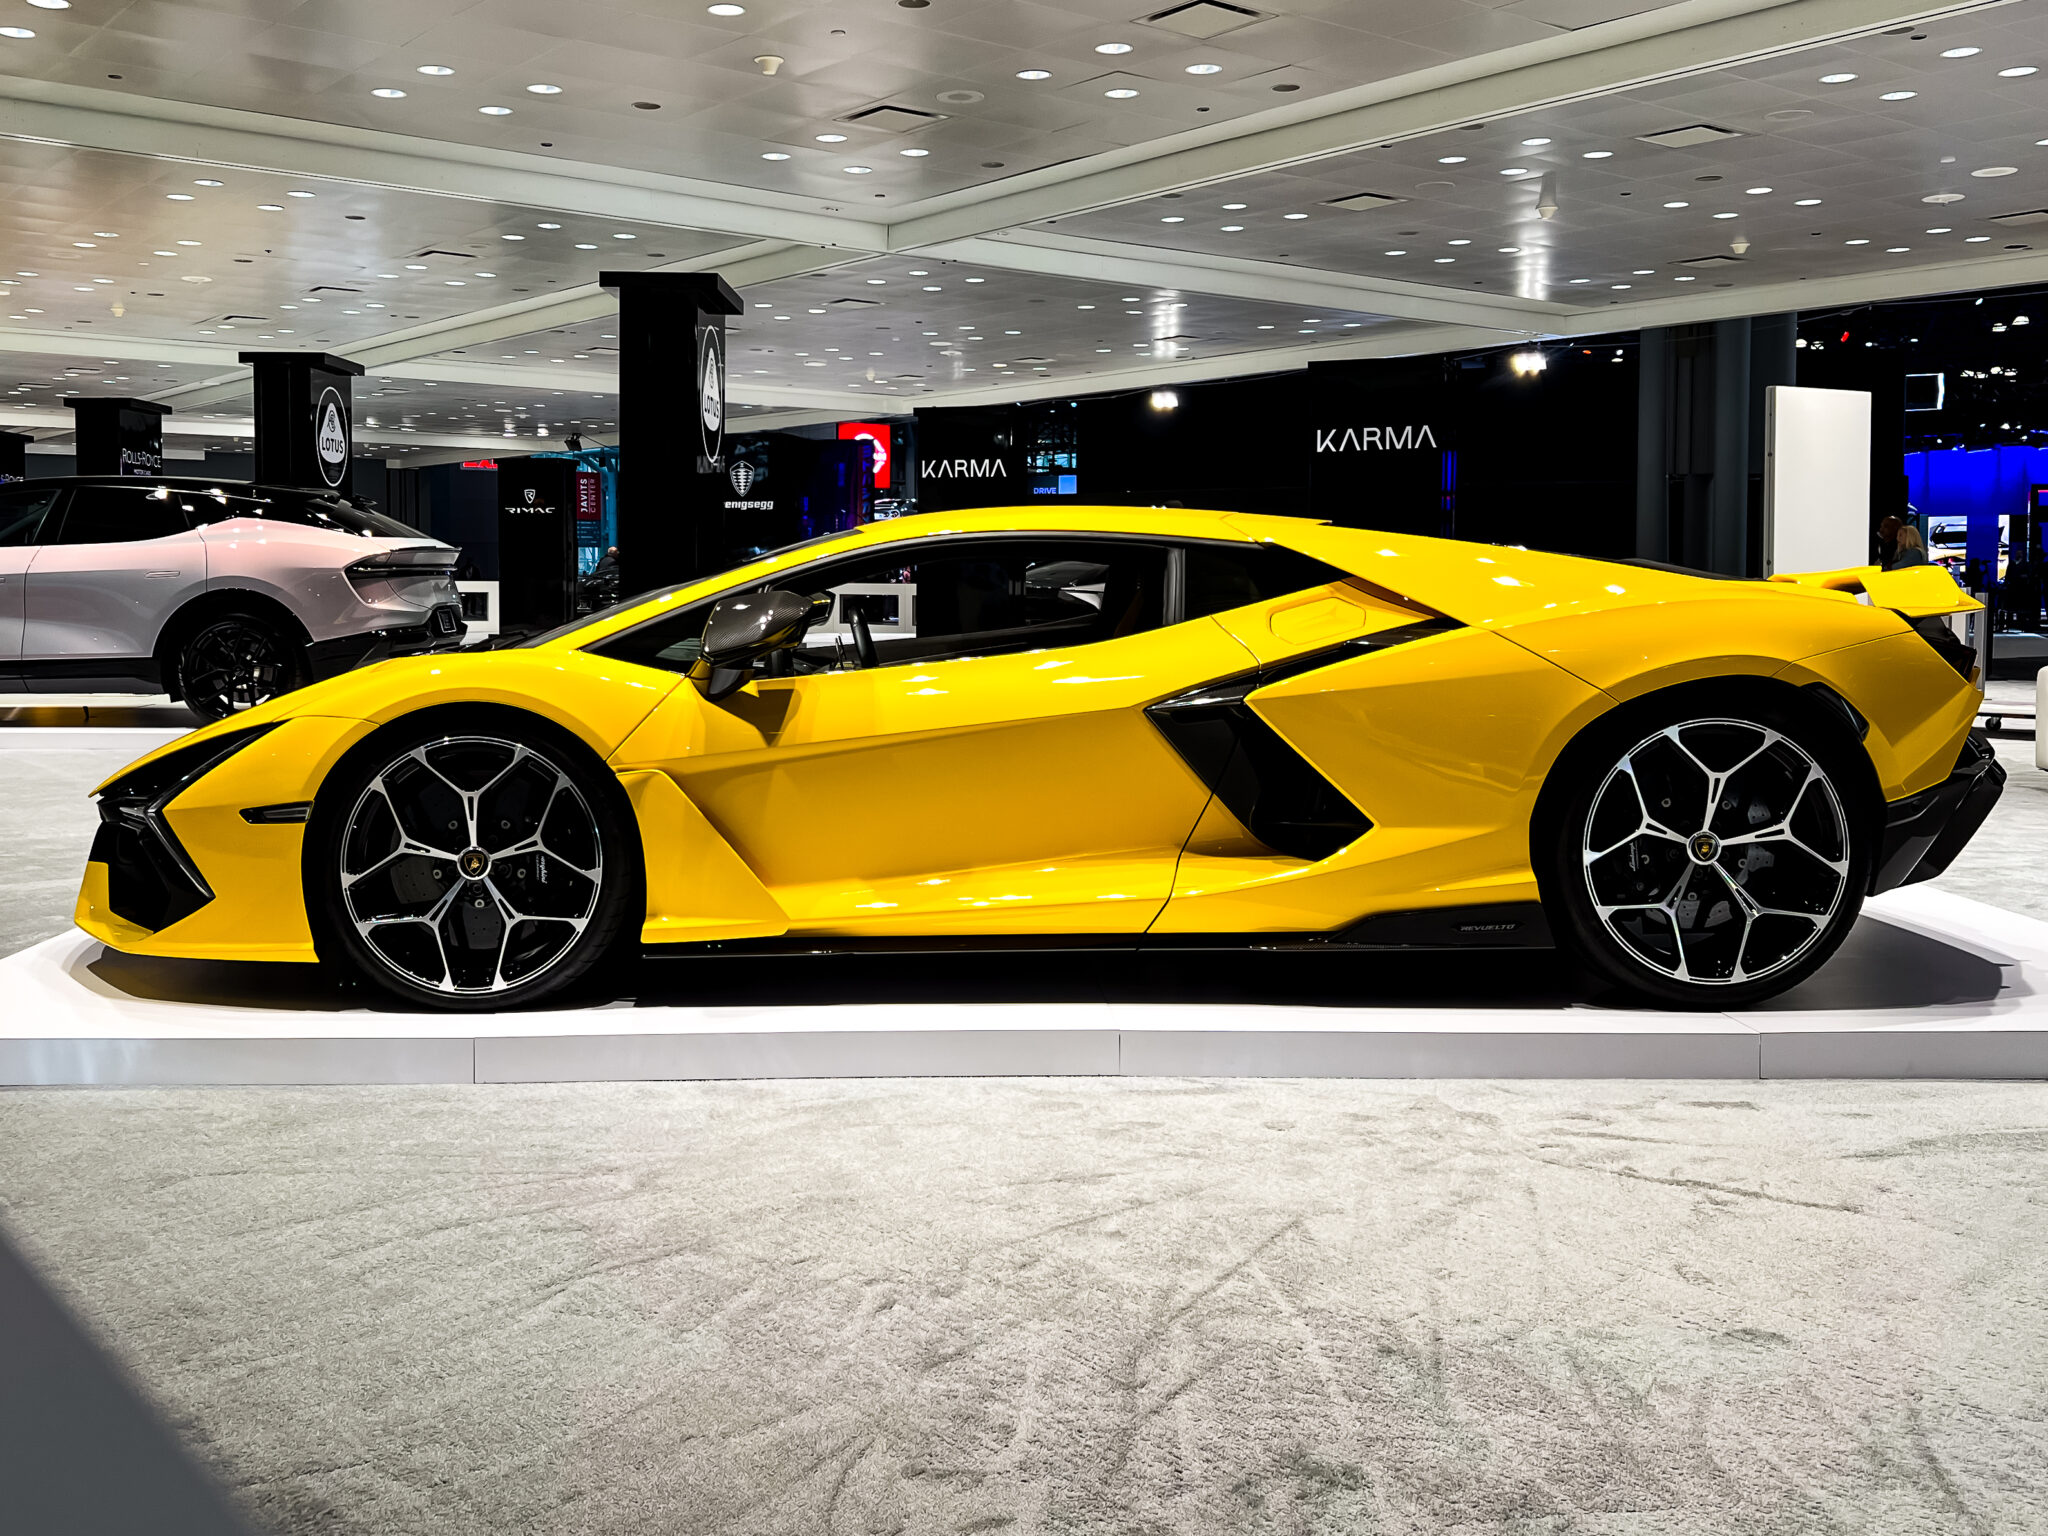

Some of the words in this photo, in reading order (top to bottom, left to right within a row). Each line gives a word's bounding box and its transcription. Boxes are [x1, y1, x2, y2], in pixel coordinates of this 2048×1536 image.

[704, 394, 720, 419] LOTUS
[321, 436, 344, 454] LOTUS
[1316, 424, 1437, 453] KARMA
[122, 447, 162, 468] ROLLS-ROYCE
[921, 458, 1007, 478] KARMA
[580, 478, 588, 513] JAVITS
[1033, 487, 1057, 495] DRIVE
[724, 500, 774, 511] enigsegg
[1460, 923, 1516, 932] REVUELTO
